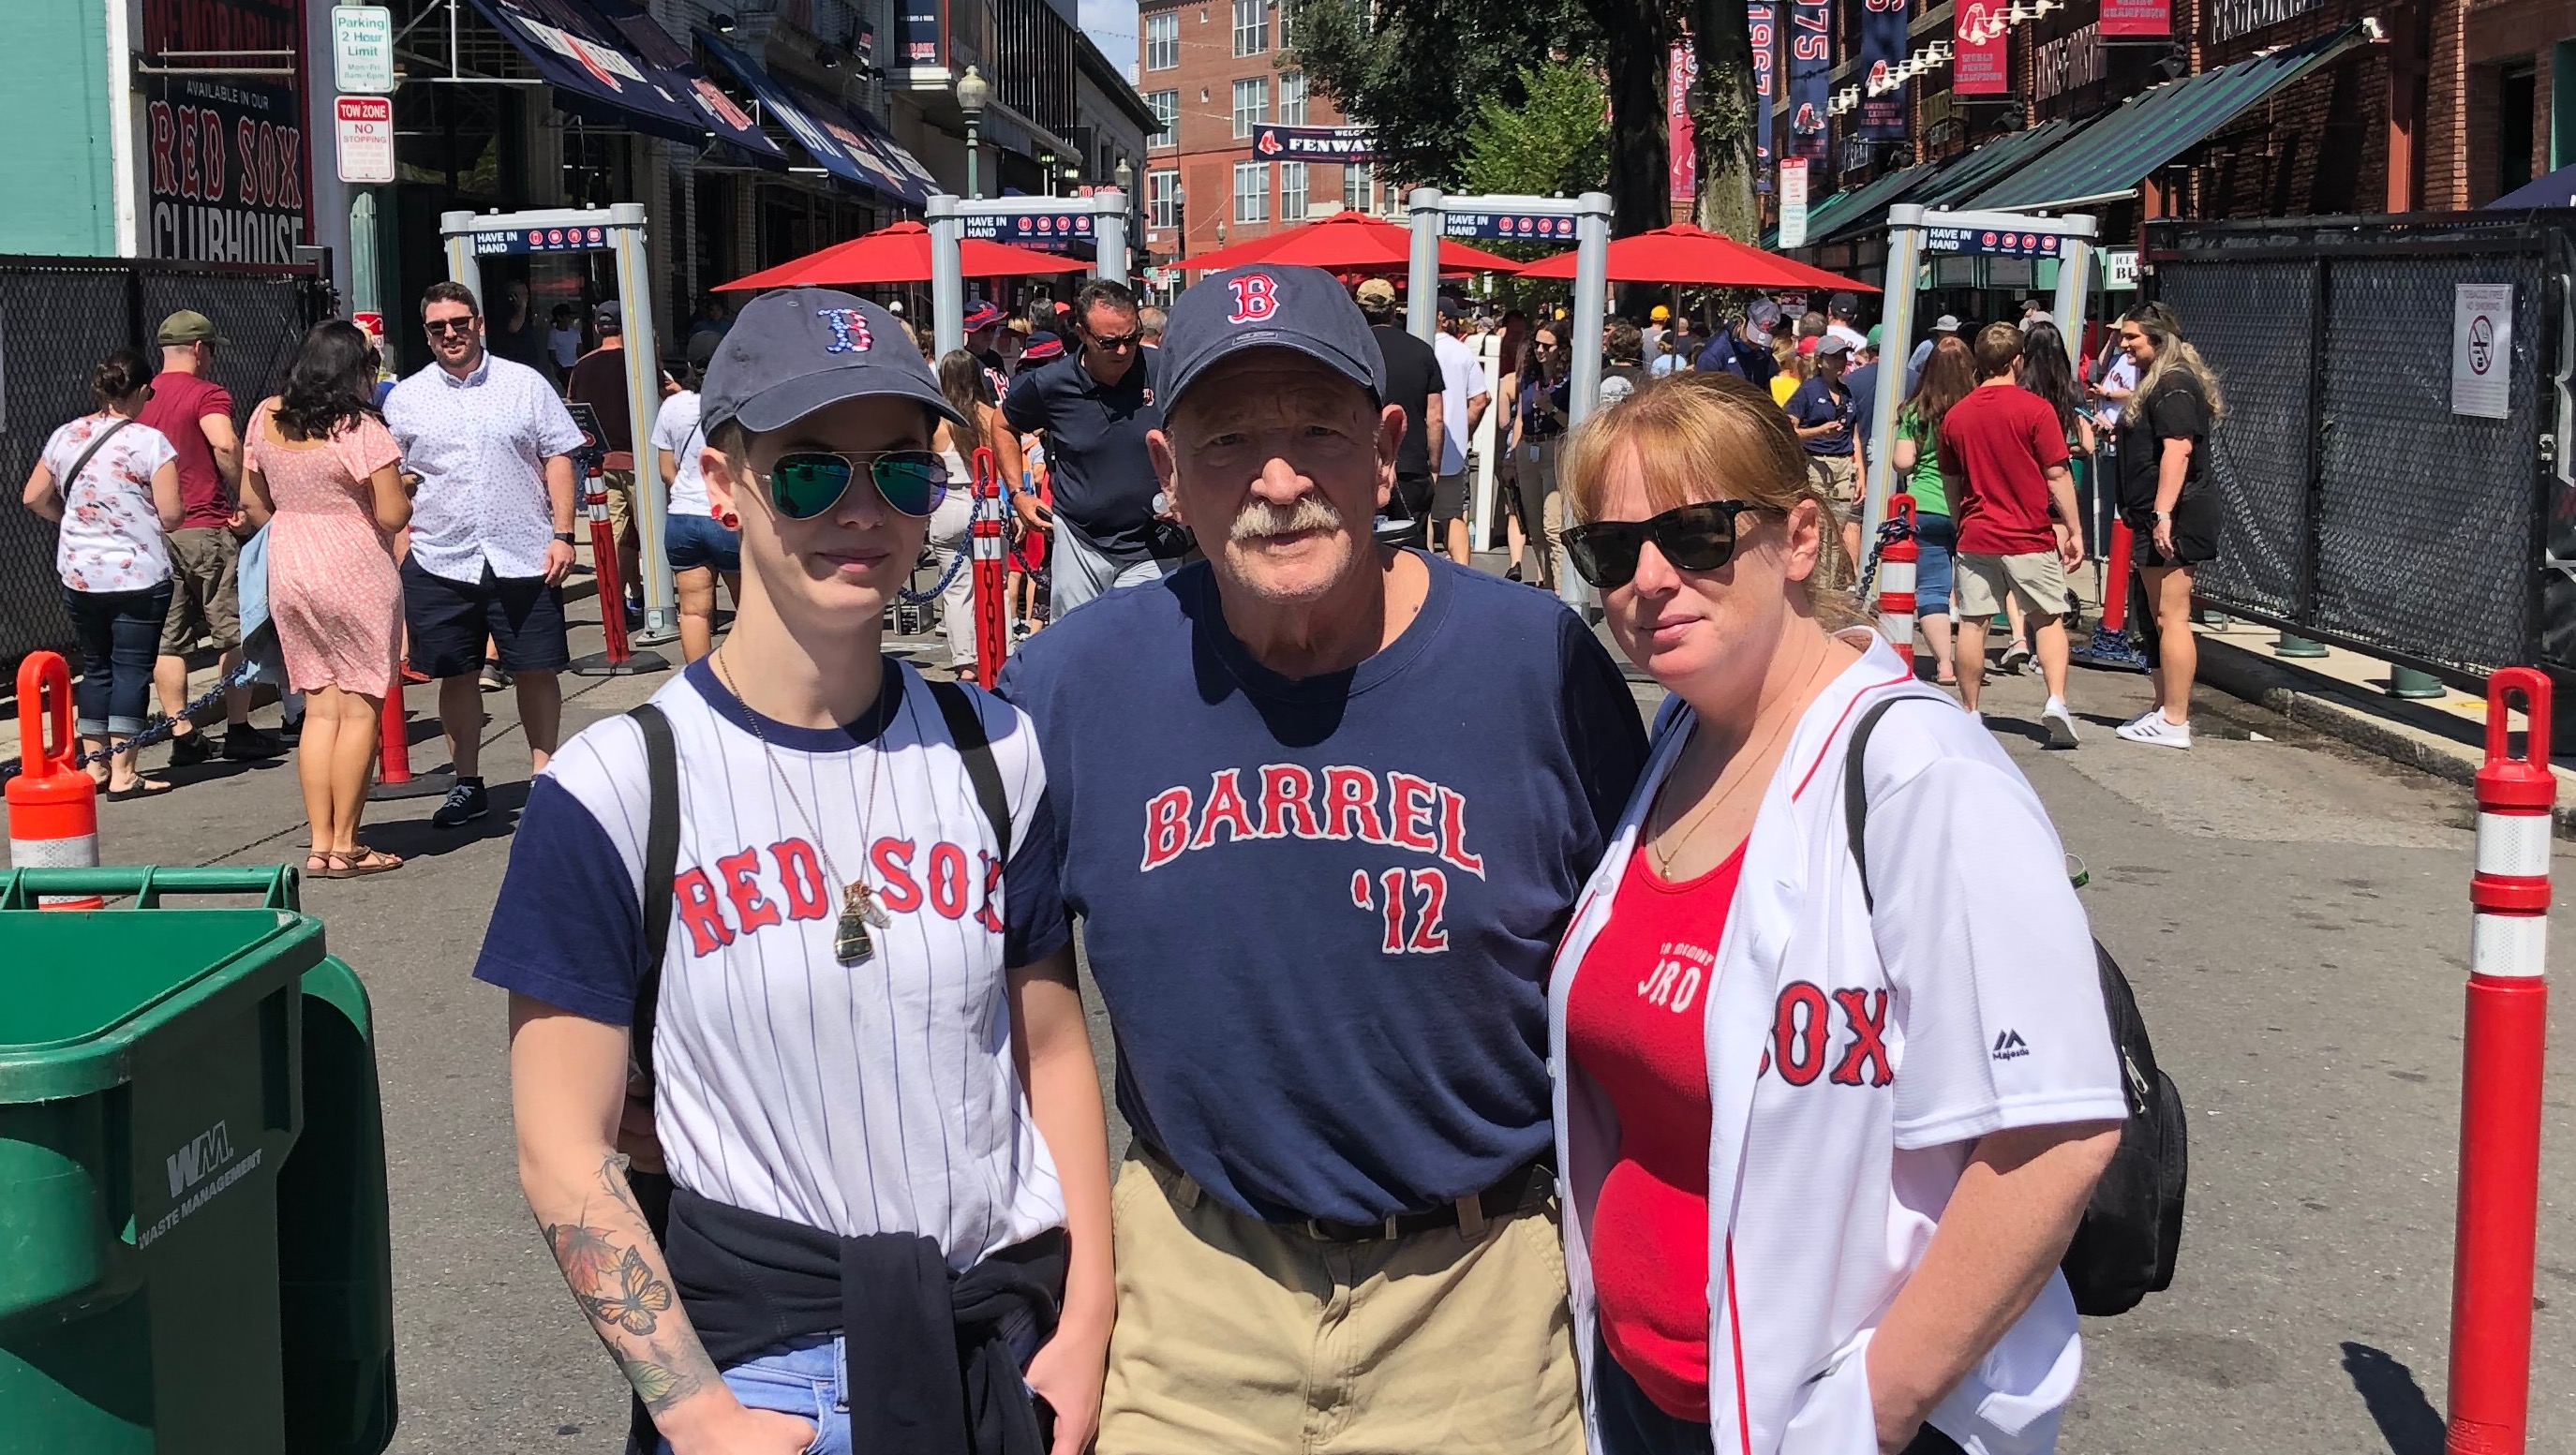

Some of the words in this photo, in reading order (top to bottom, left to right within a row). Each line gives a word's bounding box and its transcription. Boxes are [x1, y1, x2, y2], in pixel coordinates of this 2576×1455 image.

[338, 17, 385, 30] Parking
[1794, 0, 1828, 60] 75
[342, 31, 350, 42] 2
[353, 31, 382, 42] Hour
[348, 45, 379, 56] Limit
[186, 80, 238, 104] AVAILABLE
[240, 92, 249, 106] IN
[251, 94, 270, 111] OUR
[340, 104, 362, 118] TOW
[362, 105, 387, 119] ZONE
[355, 124, 374, 134] NO
[149, 99, 226, 201] RED
[238, 115, 303, 209] SOX
[967, 216, 994, 227] HAVE
[996, 216, 1007, 226] IN
[1447, 214, 1476, 226] HAVE
[1477, 215, 1489, 226] IN
[477, 231, 505, 243] HAVE
[506, 230, 518, 242] IN
[967, 228, 997, 237] HAND
[1447, 225, 1477, 236] HAND
[1929, 229, 1958, 240] HAVE
[1959, 230, 1973, 241] IN
[478, 243, 508, 254] HAND
[1928, 240, 1959, 250] HAND
[2116, 256, 2132, 265] ICE
[2116, 267, 2137, 279] BE
[1227, 272, 1281, 325] B
[817, 308, 874, 354] B
[1139, 763, 1486, 883] BARREL
[673, 837, 829, 958] RED
[1350, 867, 1451, 955] '12
[1660, 942, 1673, 956] IN
[1672, 941, 1715, 967] MEMORY
[1758, 980, 1894, 1088] OX
[1992, 1047, 2030, 1062] Majestic
[166, 1120, 231, 1199] WM
[139, 1208, 180, 1251] WASTE
[181, 1148, 262, 1218] MANAGEMENT
